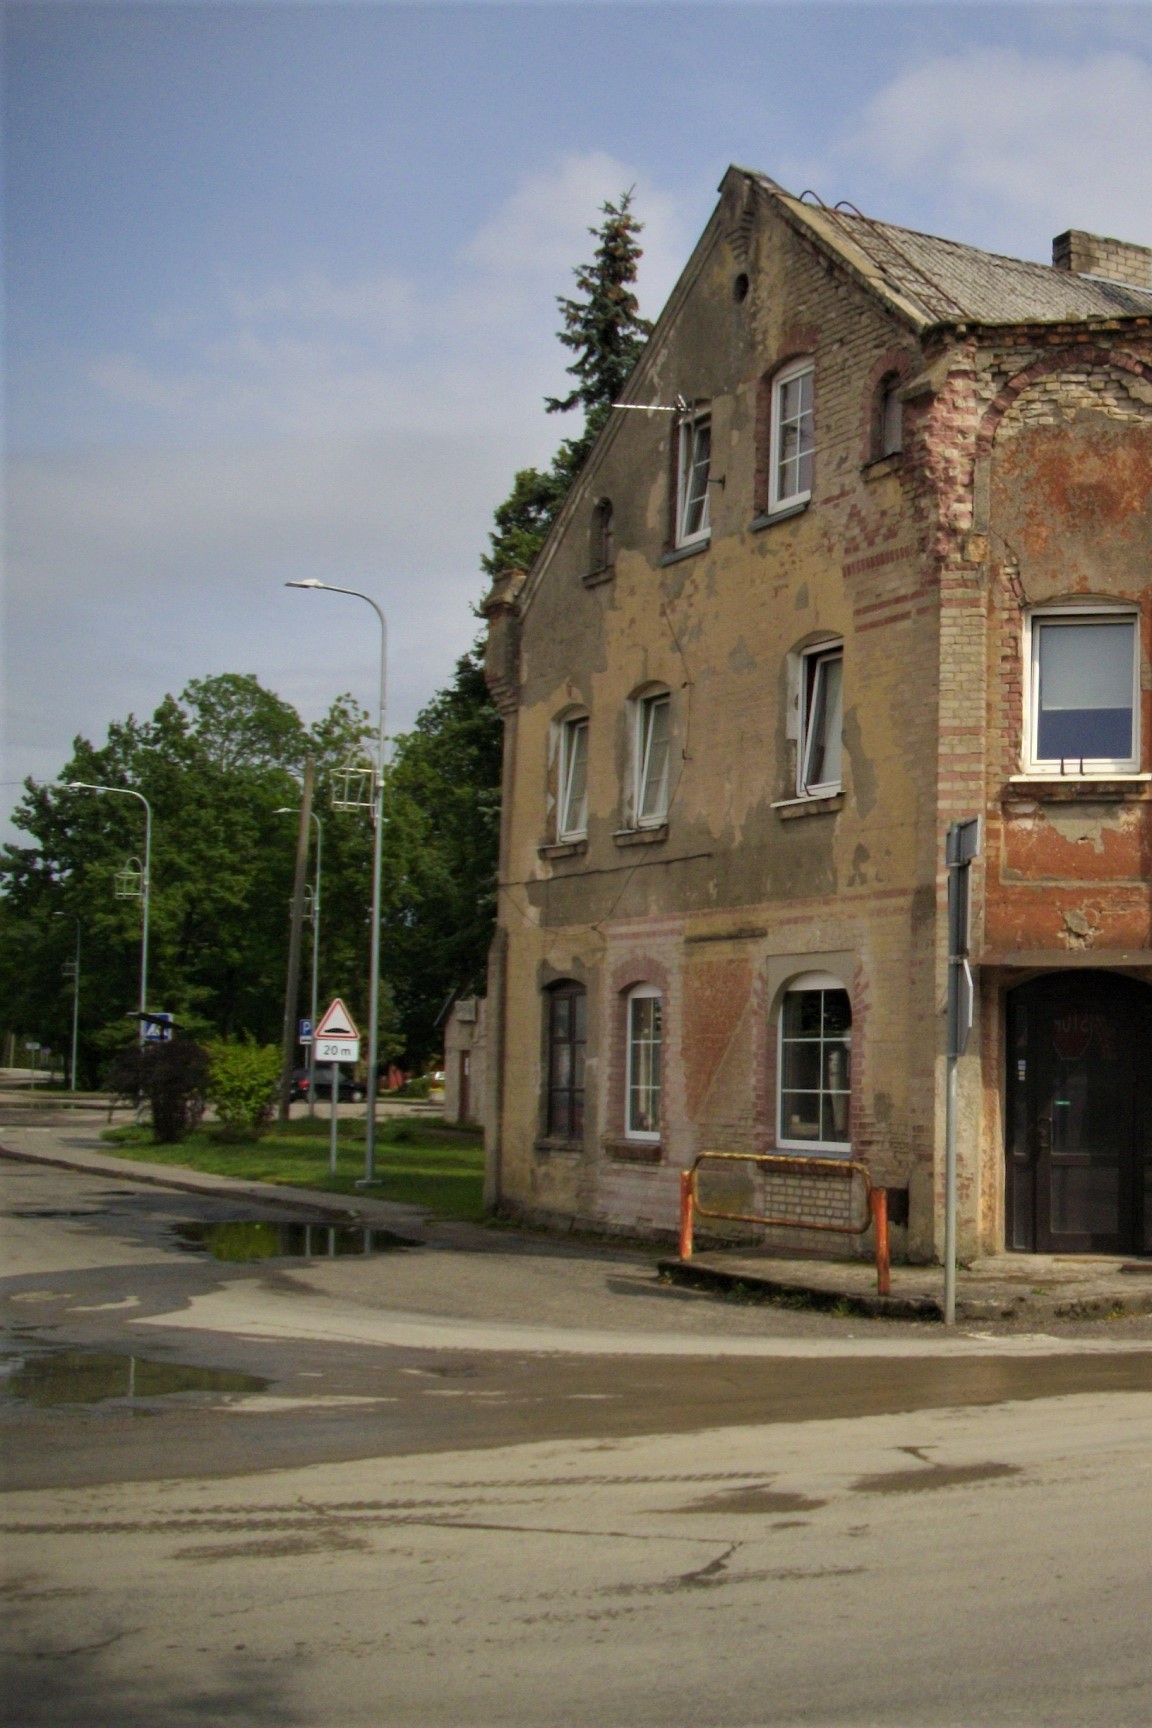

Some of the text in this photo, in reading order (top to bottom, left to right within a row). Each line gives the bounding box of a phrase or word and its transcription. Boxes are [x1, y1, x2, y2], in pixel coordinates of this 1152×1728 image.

[302, 1021, 312, 1035] P
[323, 1045, 351, 1056] 20 m
